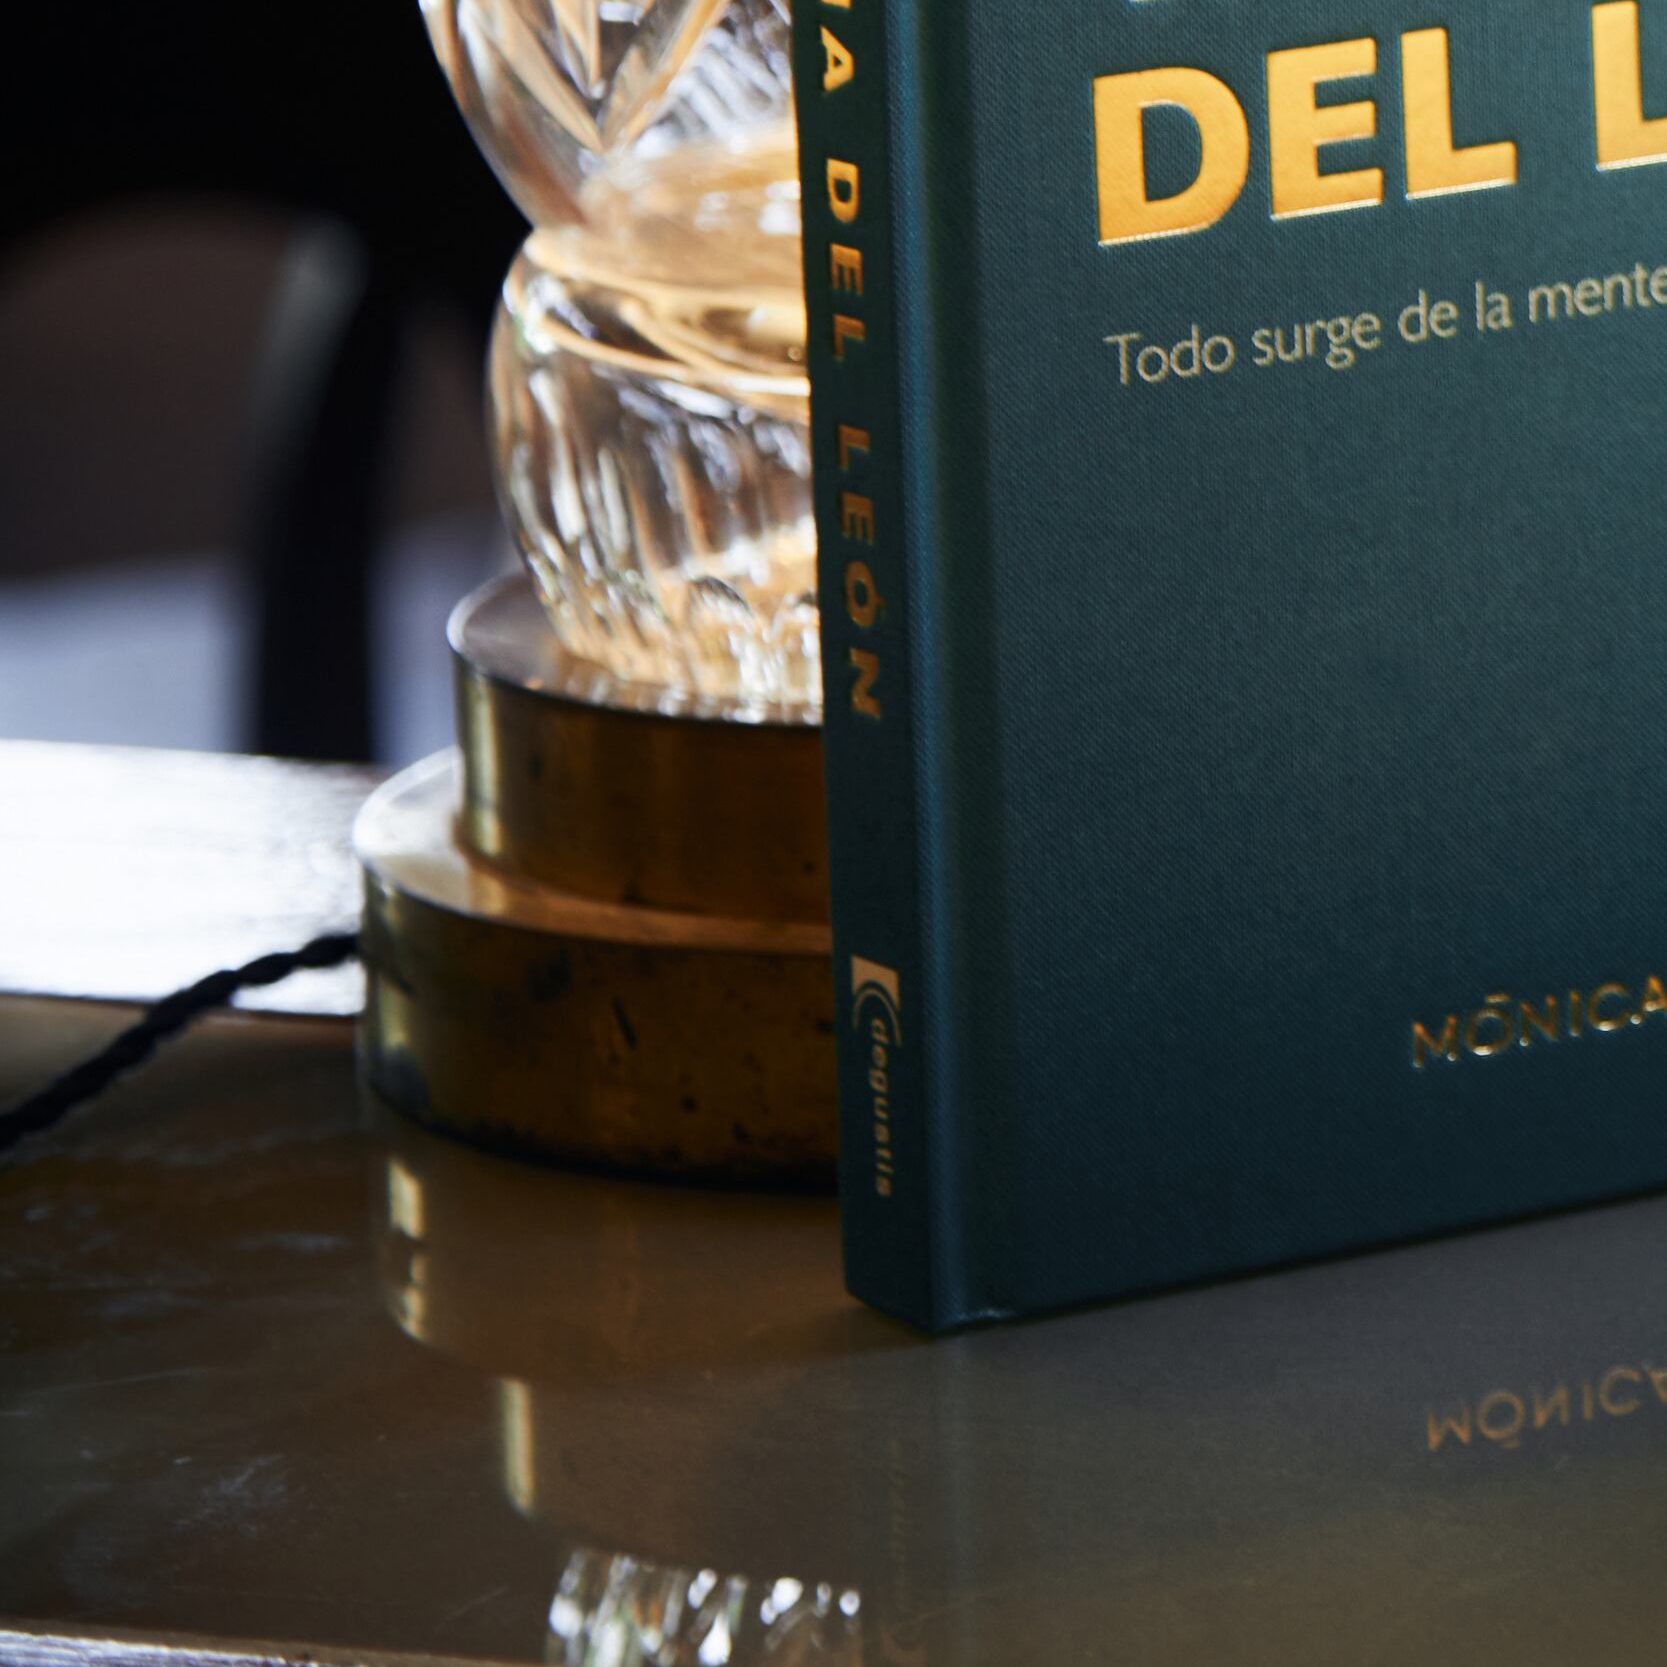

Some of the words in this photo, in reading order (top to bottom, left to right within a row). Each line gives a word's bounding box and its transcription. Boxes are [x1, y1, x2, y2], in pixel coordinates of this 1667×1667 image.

[1091, 25, 1519, 246] DEL
[825, 157, 867, 362] DEL
[1103, 321, 1236, 387] Todo
[1251, 312, 1381, 369] surge
[1398, 288, 1461, 344] de
[1475, 279, 1512, 334] la
[836, 422, 886, 720] LEÓN
[866, 1016, 896, 1198] degustis
